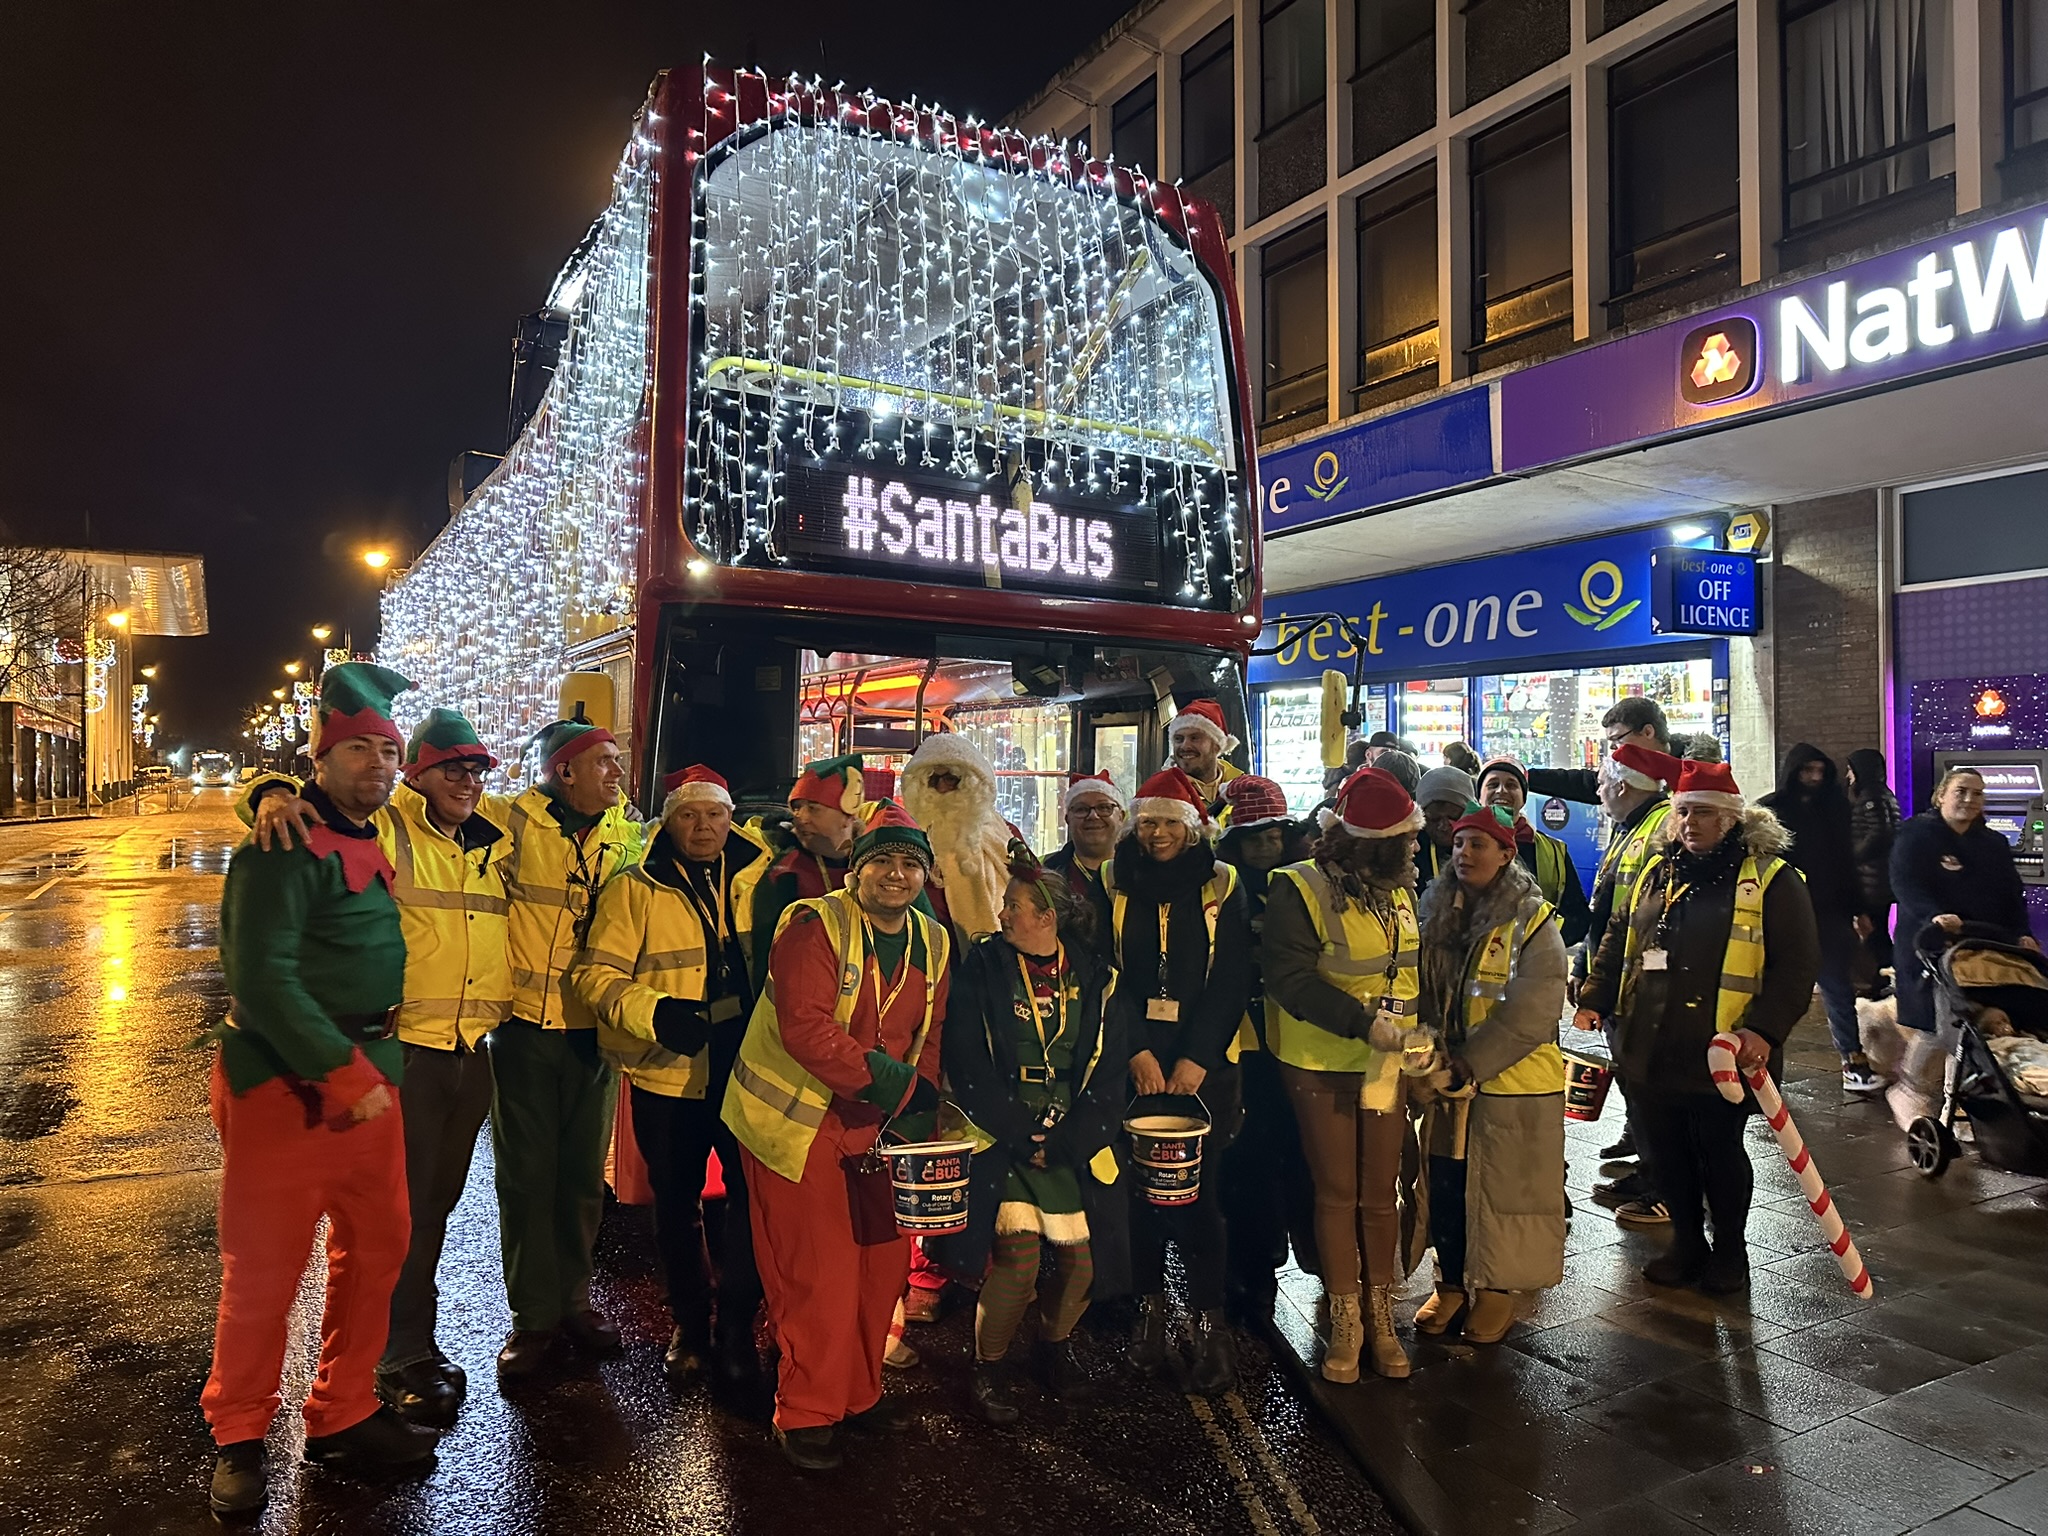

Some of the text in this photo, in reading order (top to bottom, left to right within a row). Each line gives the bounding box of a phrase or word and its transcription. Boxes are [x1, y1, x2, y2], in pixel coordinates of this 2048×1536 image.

[842, 475, 1115, 580] #SantaBus
[1733, 524, 1752, 540] ADT
[1681, 557, 1733, 576] best-one
[1698, 579, 1731, 601] OFF
[1680, 603, 1750, 628] LICENCE
[1162, 1142, 1186, 1150] SANTA
[935, 1157, 961, 1167] SANTA
[1161, 1150, 1187, 1160] BUS
[935, 1165, 961, 1180] BUS
[1158, 1171, 1177, 1179] Rotary
[931, 1194, 952, 1202] Rotary
